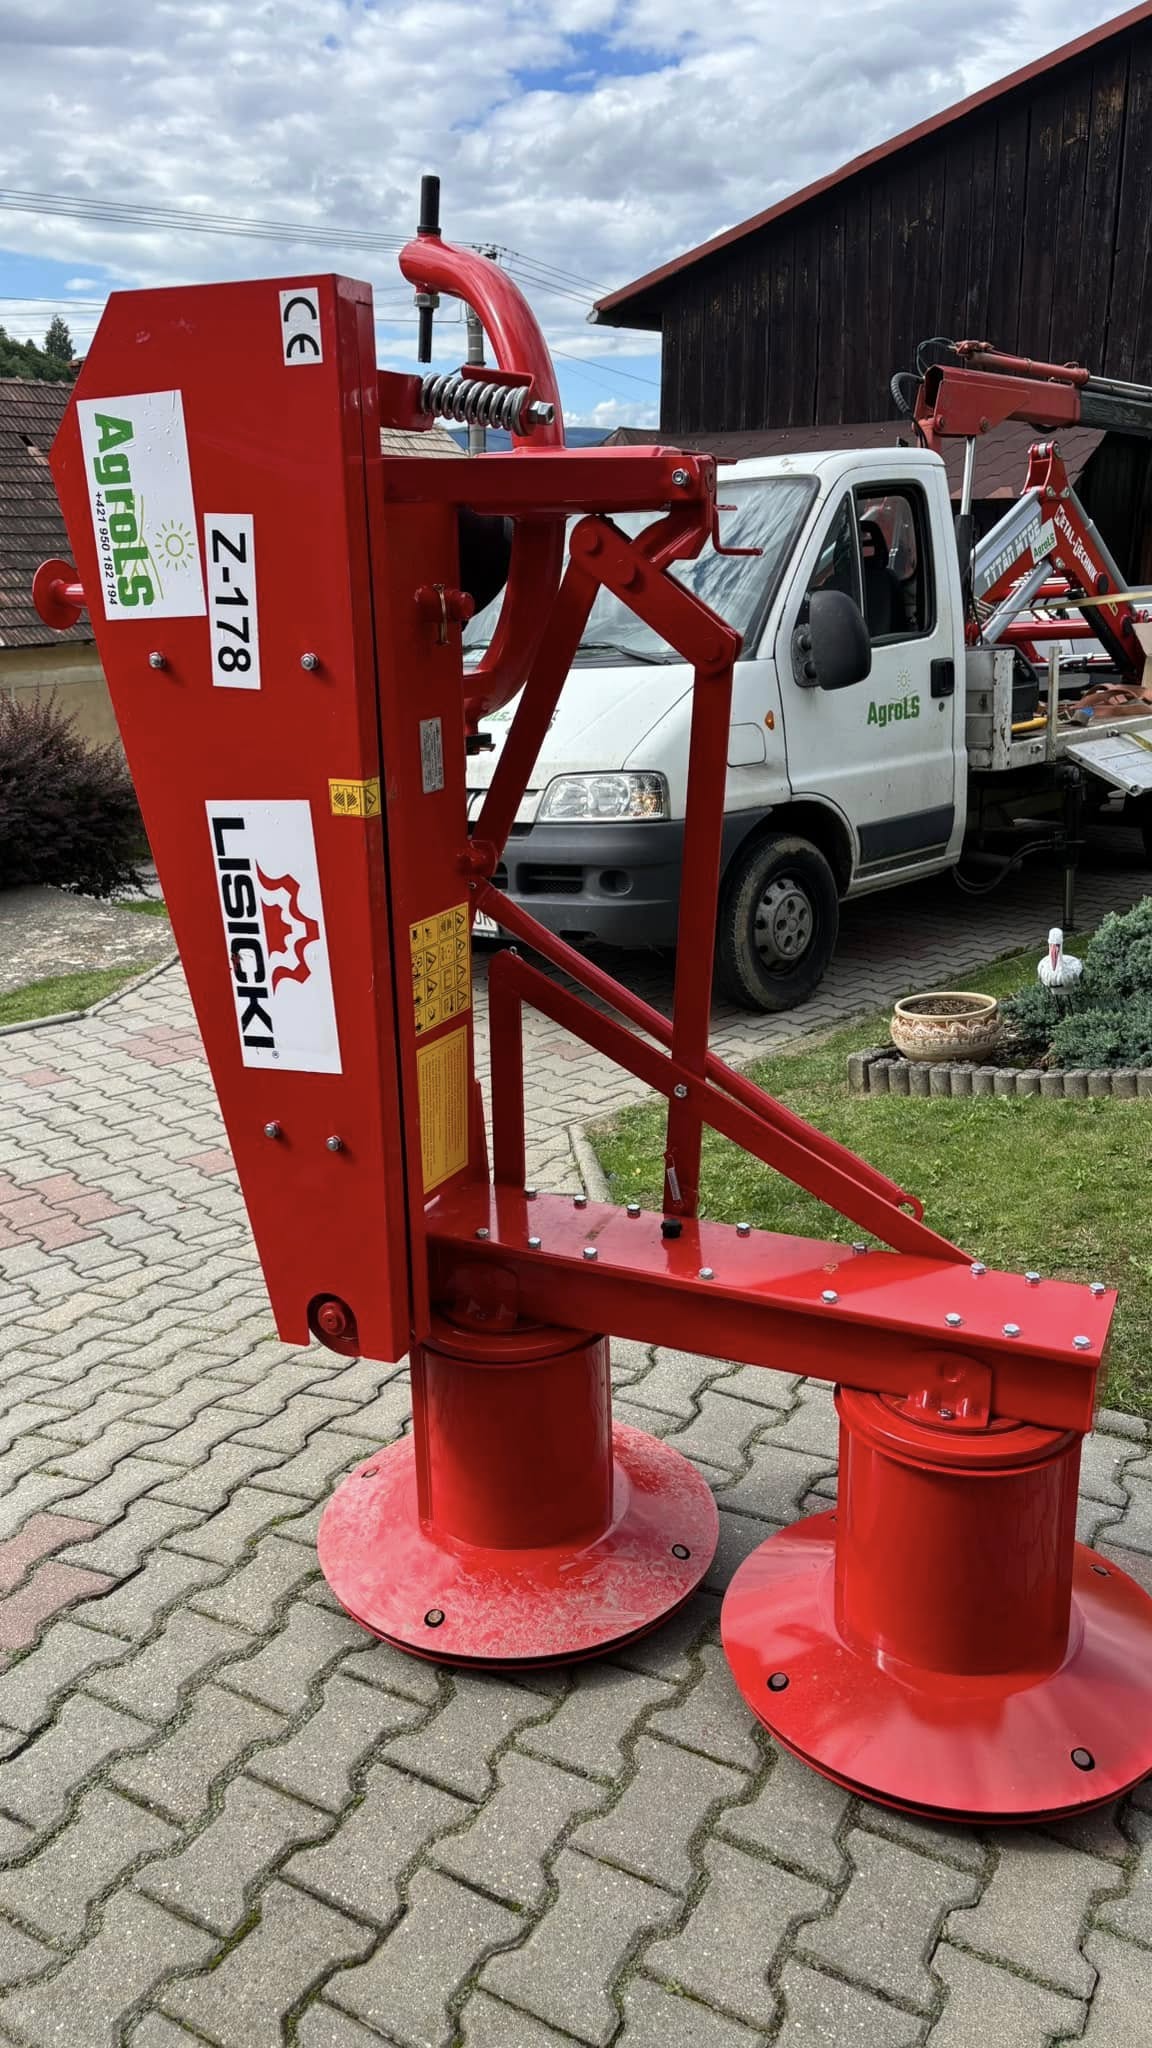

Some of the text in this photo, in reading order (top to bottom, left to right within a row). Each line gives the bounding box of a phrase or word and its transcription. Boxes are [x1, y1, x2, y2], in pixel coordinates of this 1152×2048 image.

[284, 296, 320, 359] CE
[93, 412, 155, 608] AgroLS
[95, 491, 118, 606] +421 950 182 194
[1033, 532, 1056, 558] AgroLS
[211, 529, 252, 673] Z-178
[867, 694, 921, 728] AgroLS
[212, 817, 275, 1049] LISICKI
